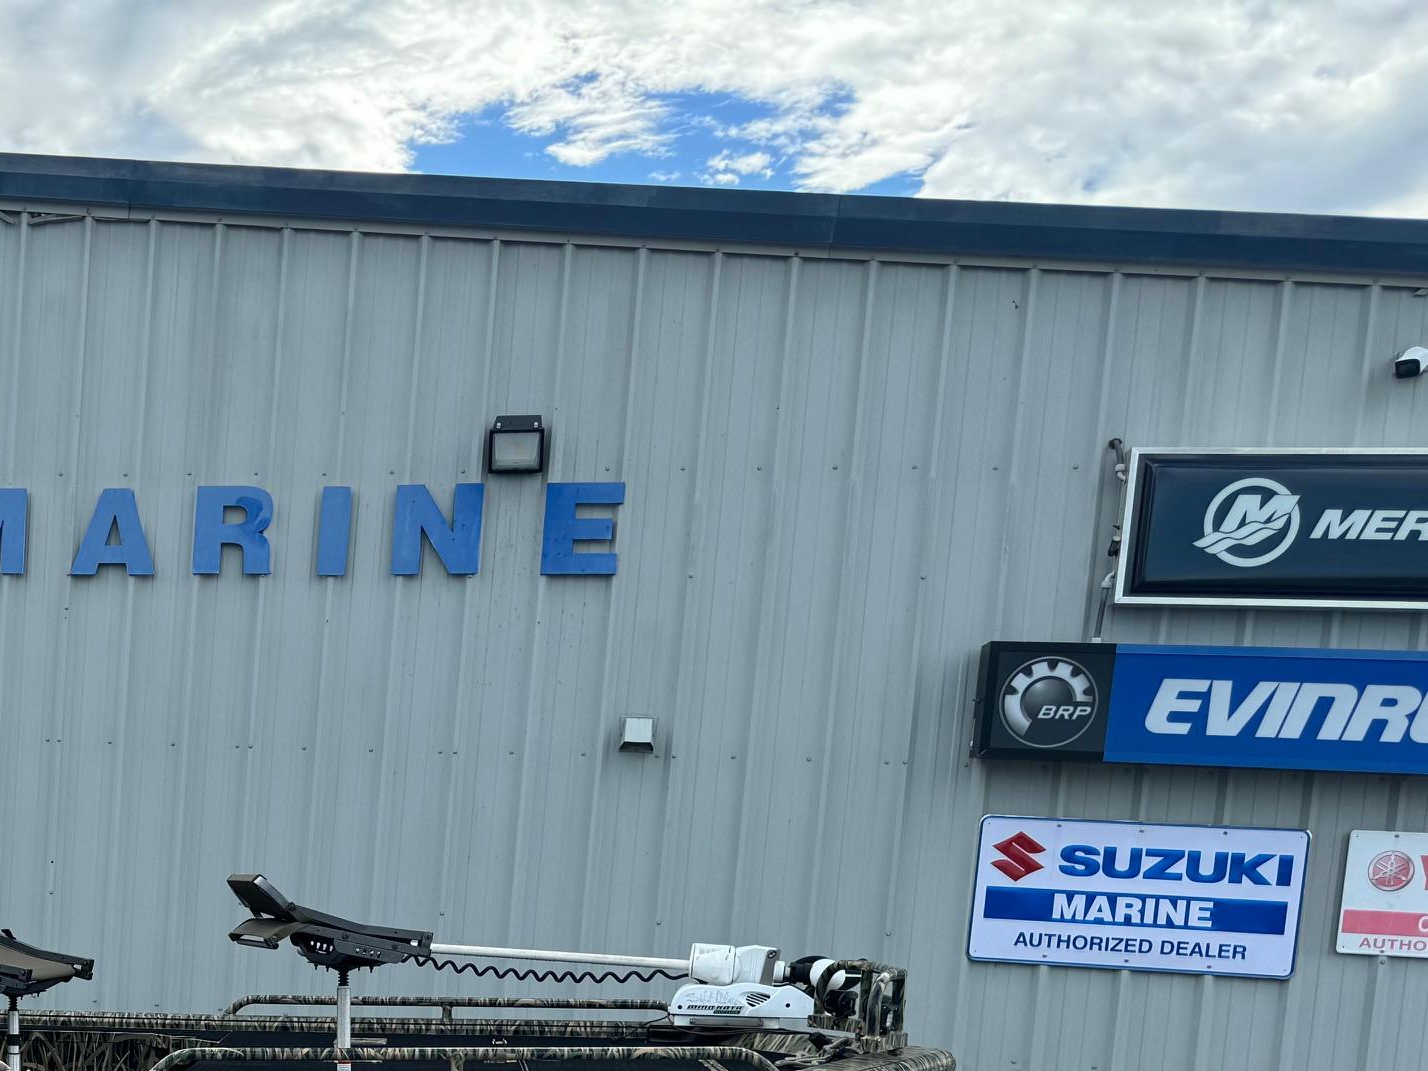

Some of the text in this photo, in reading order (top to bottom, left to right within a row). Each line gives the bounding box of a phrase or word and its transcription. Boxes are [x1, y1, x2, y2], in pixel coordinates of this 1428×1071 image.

[1037, 704, 1092, 720] BRP
[1145, 679, 1428, 744] EVINR
[1058, 844, 1294, 887] SUZUKI
[1052, 892, 1214, 928] MARINE
[1013, 931, 1247, 960] AUTHORIZED DEALER
